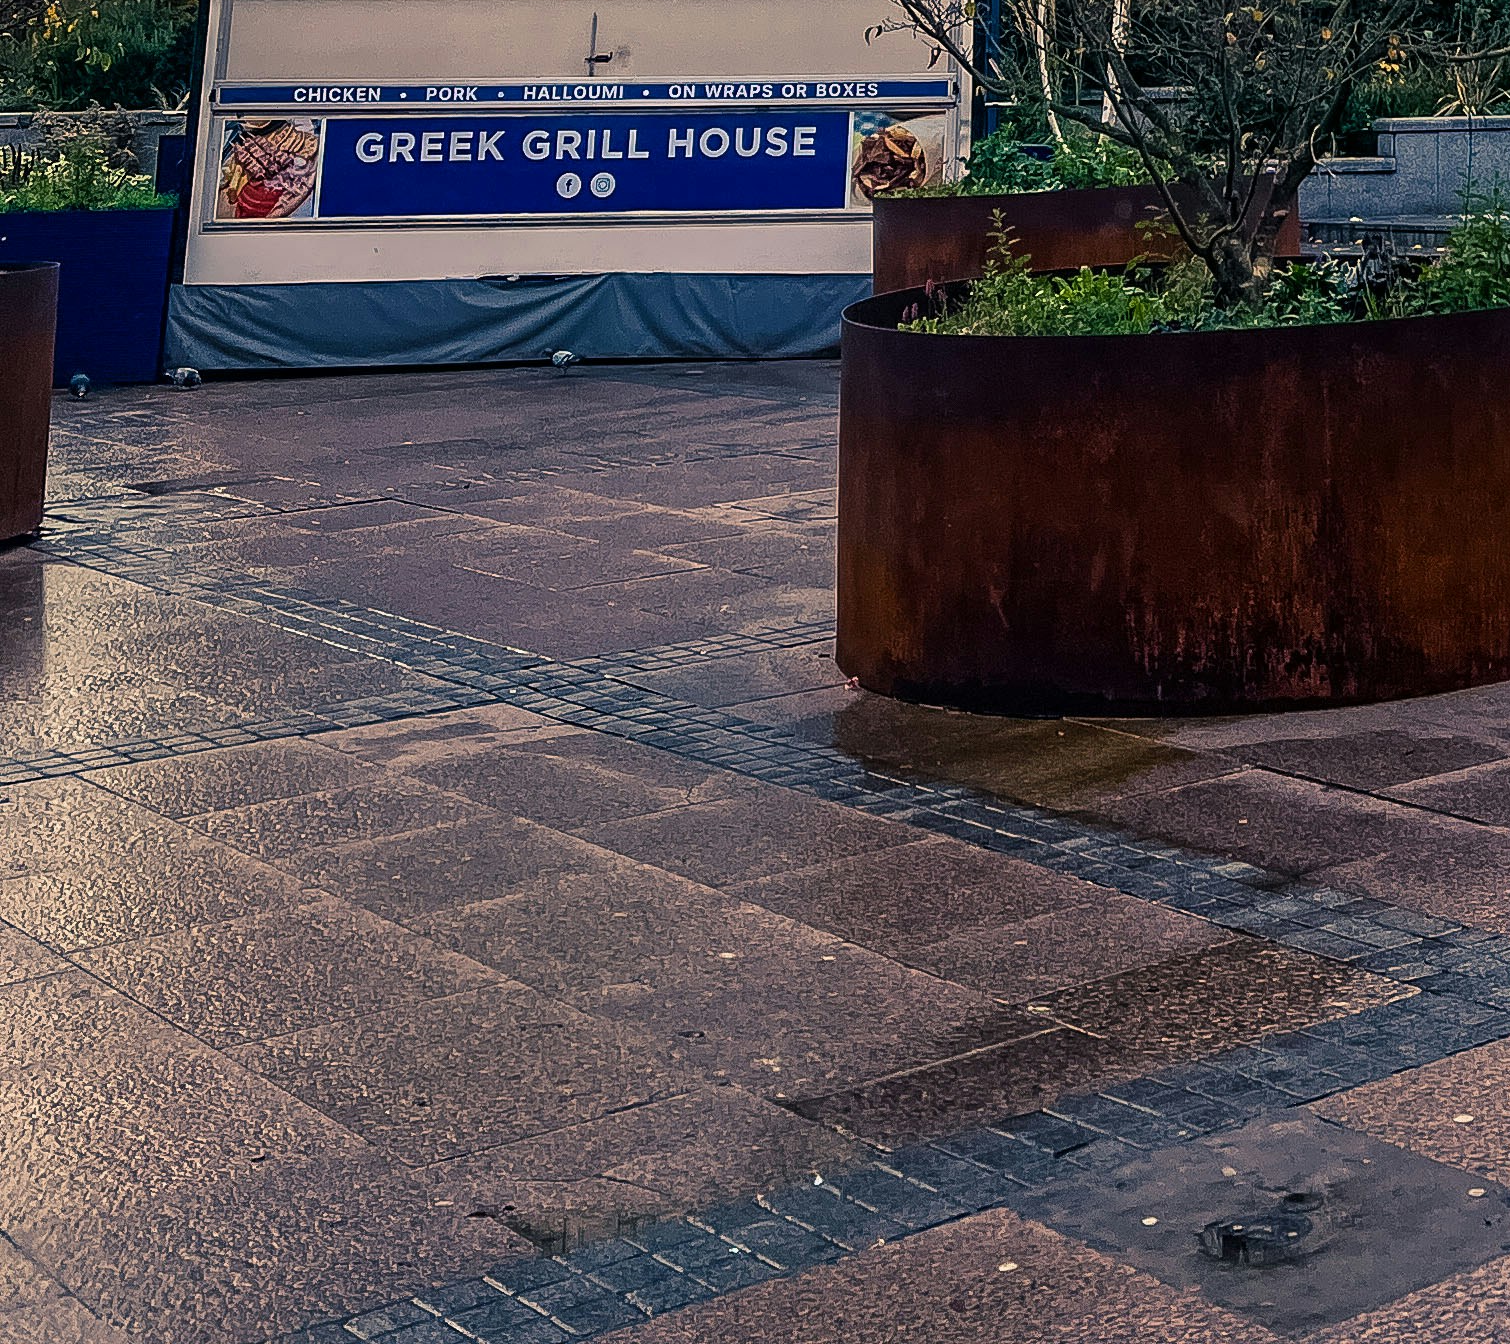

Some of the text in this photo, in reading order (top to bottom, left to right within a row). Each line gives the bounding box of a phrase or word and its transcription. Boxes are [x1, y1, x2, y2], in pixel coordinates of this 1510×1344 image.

[294, 83, 879, 102] CHICKEN PORK HALLOUMI ON WRAPS OR BOXES
[355, 127, 817, 162] GREEK GRILL HOUSE
